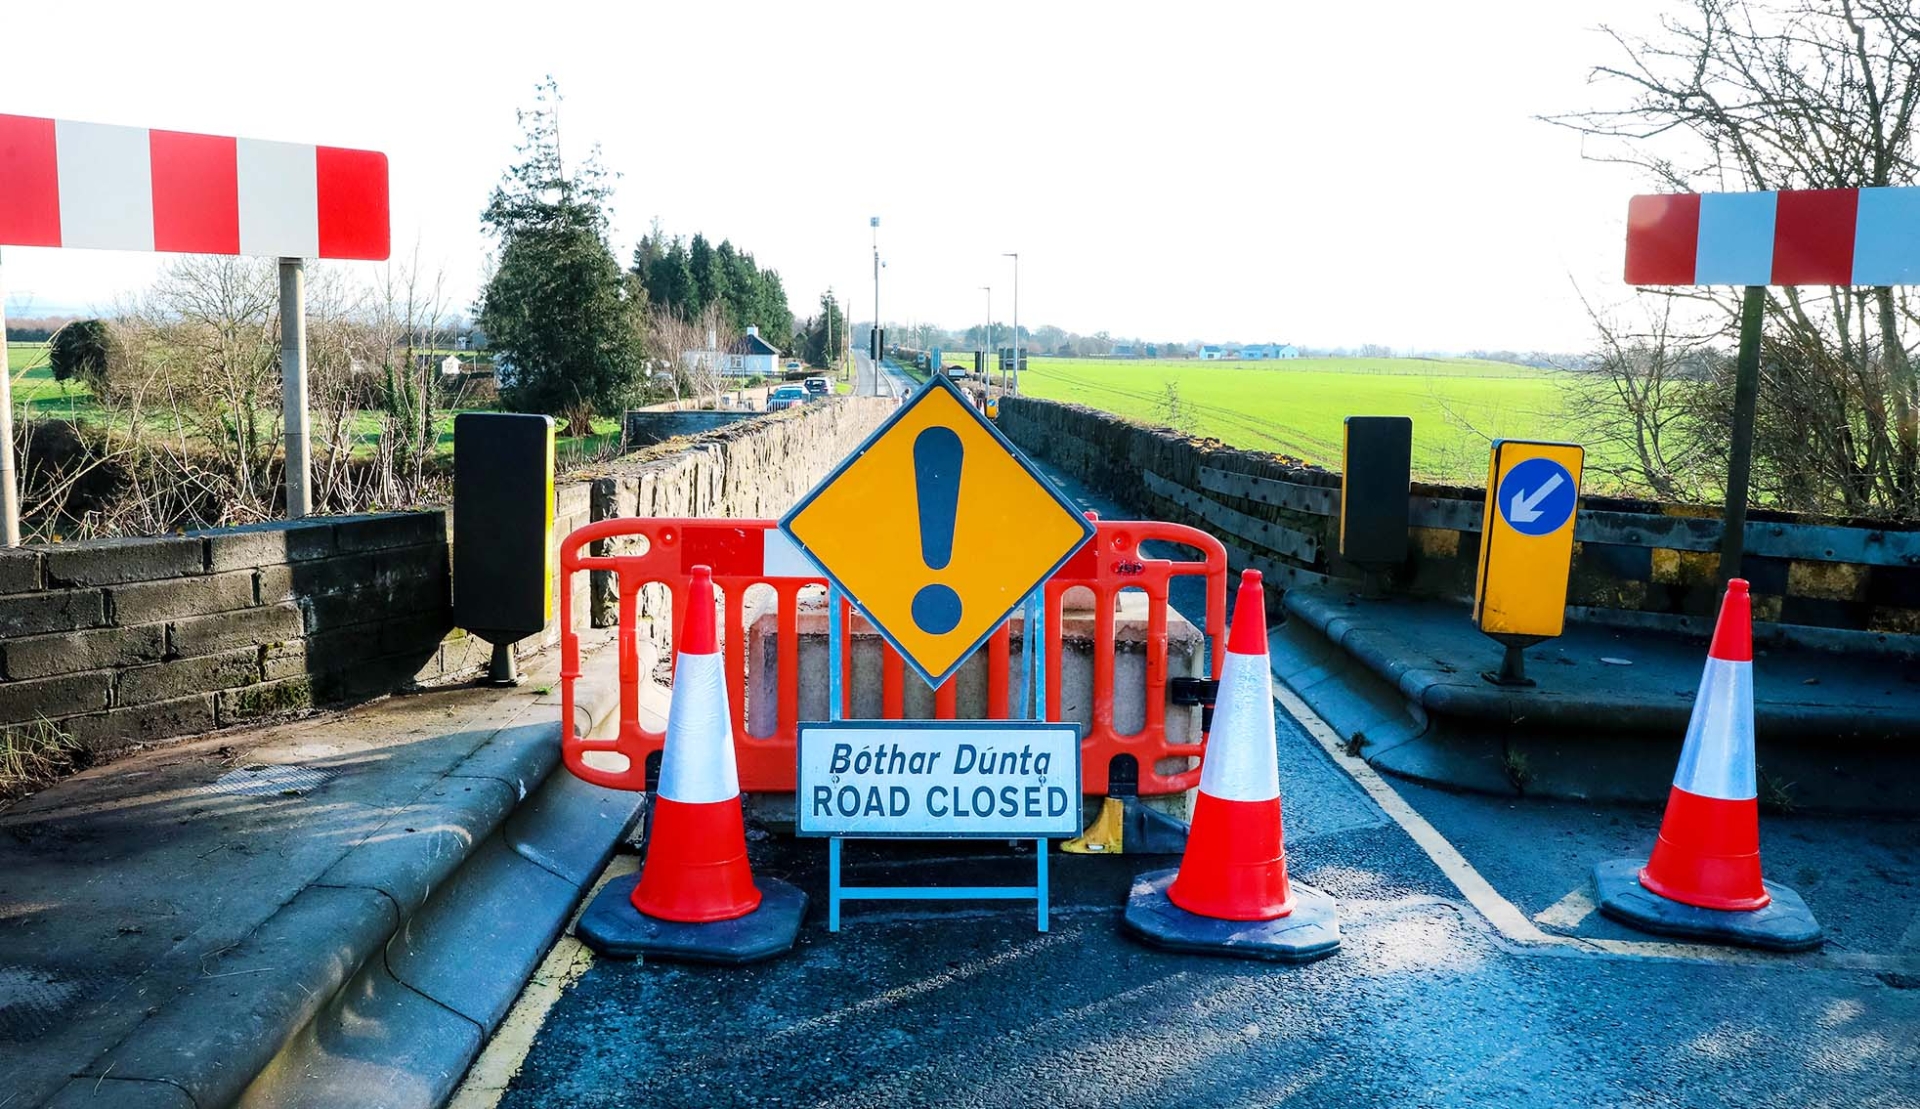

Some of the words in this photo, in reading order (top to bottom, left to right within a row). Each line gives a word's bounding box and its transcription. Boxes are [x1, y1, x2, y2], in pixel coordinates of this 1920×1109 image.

[829, 743, 941, 775] Bóthar
[953, 743, 1051, 775] Dúnta
[813, 785, 911, 817] ROAD
[926, 785, 1068, 818] CLOSED
